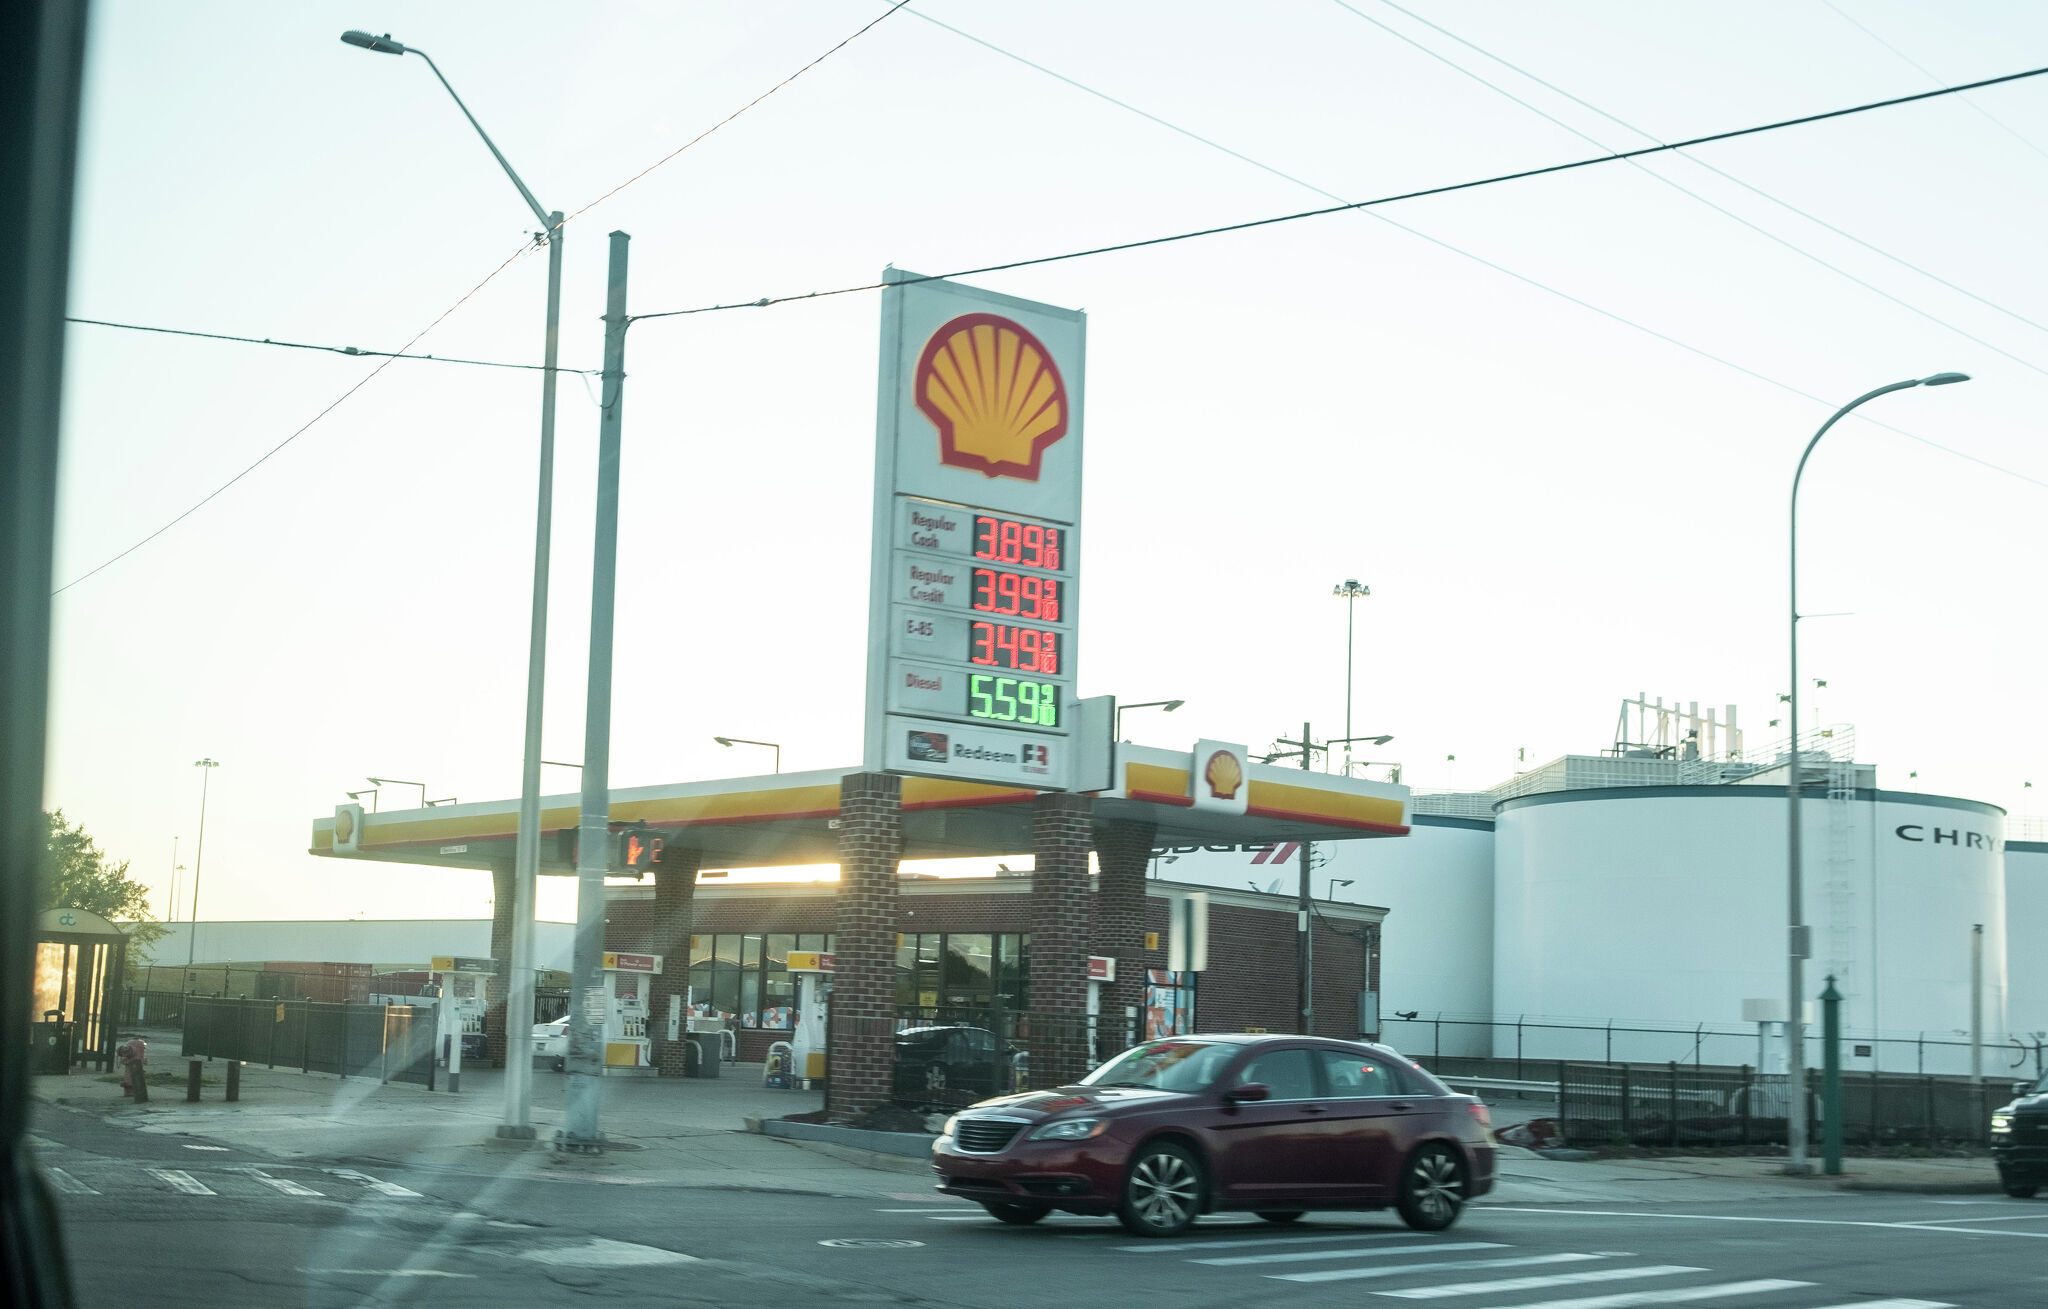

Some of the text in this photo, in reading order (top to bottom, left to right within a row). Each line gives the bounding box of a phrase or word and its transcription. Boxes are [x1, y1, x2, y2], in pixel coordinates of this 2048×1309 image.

[912, 511, 957, 531] Regular
[912, 531, 939, 548] Cash
[976, 516, 1044, 568] 3.89
[911, 565, 955, 585] Regular
[910, 585, 945, 603] Credit
[974, 568, 1042, 619] 3.99
[907, 619, 934, 636] E-85
[972, 621, 1041, 672] 3.49
[906, 673, 942, 691] Diesel
[970, 674, 1040, 723] 5.59
[954, 743, 1017, 764] Redeem
